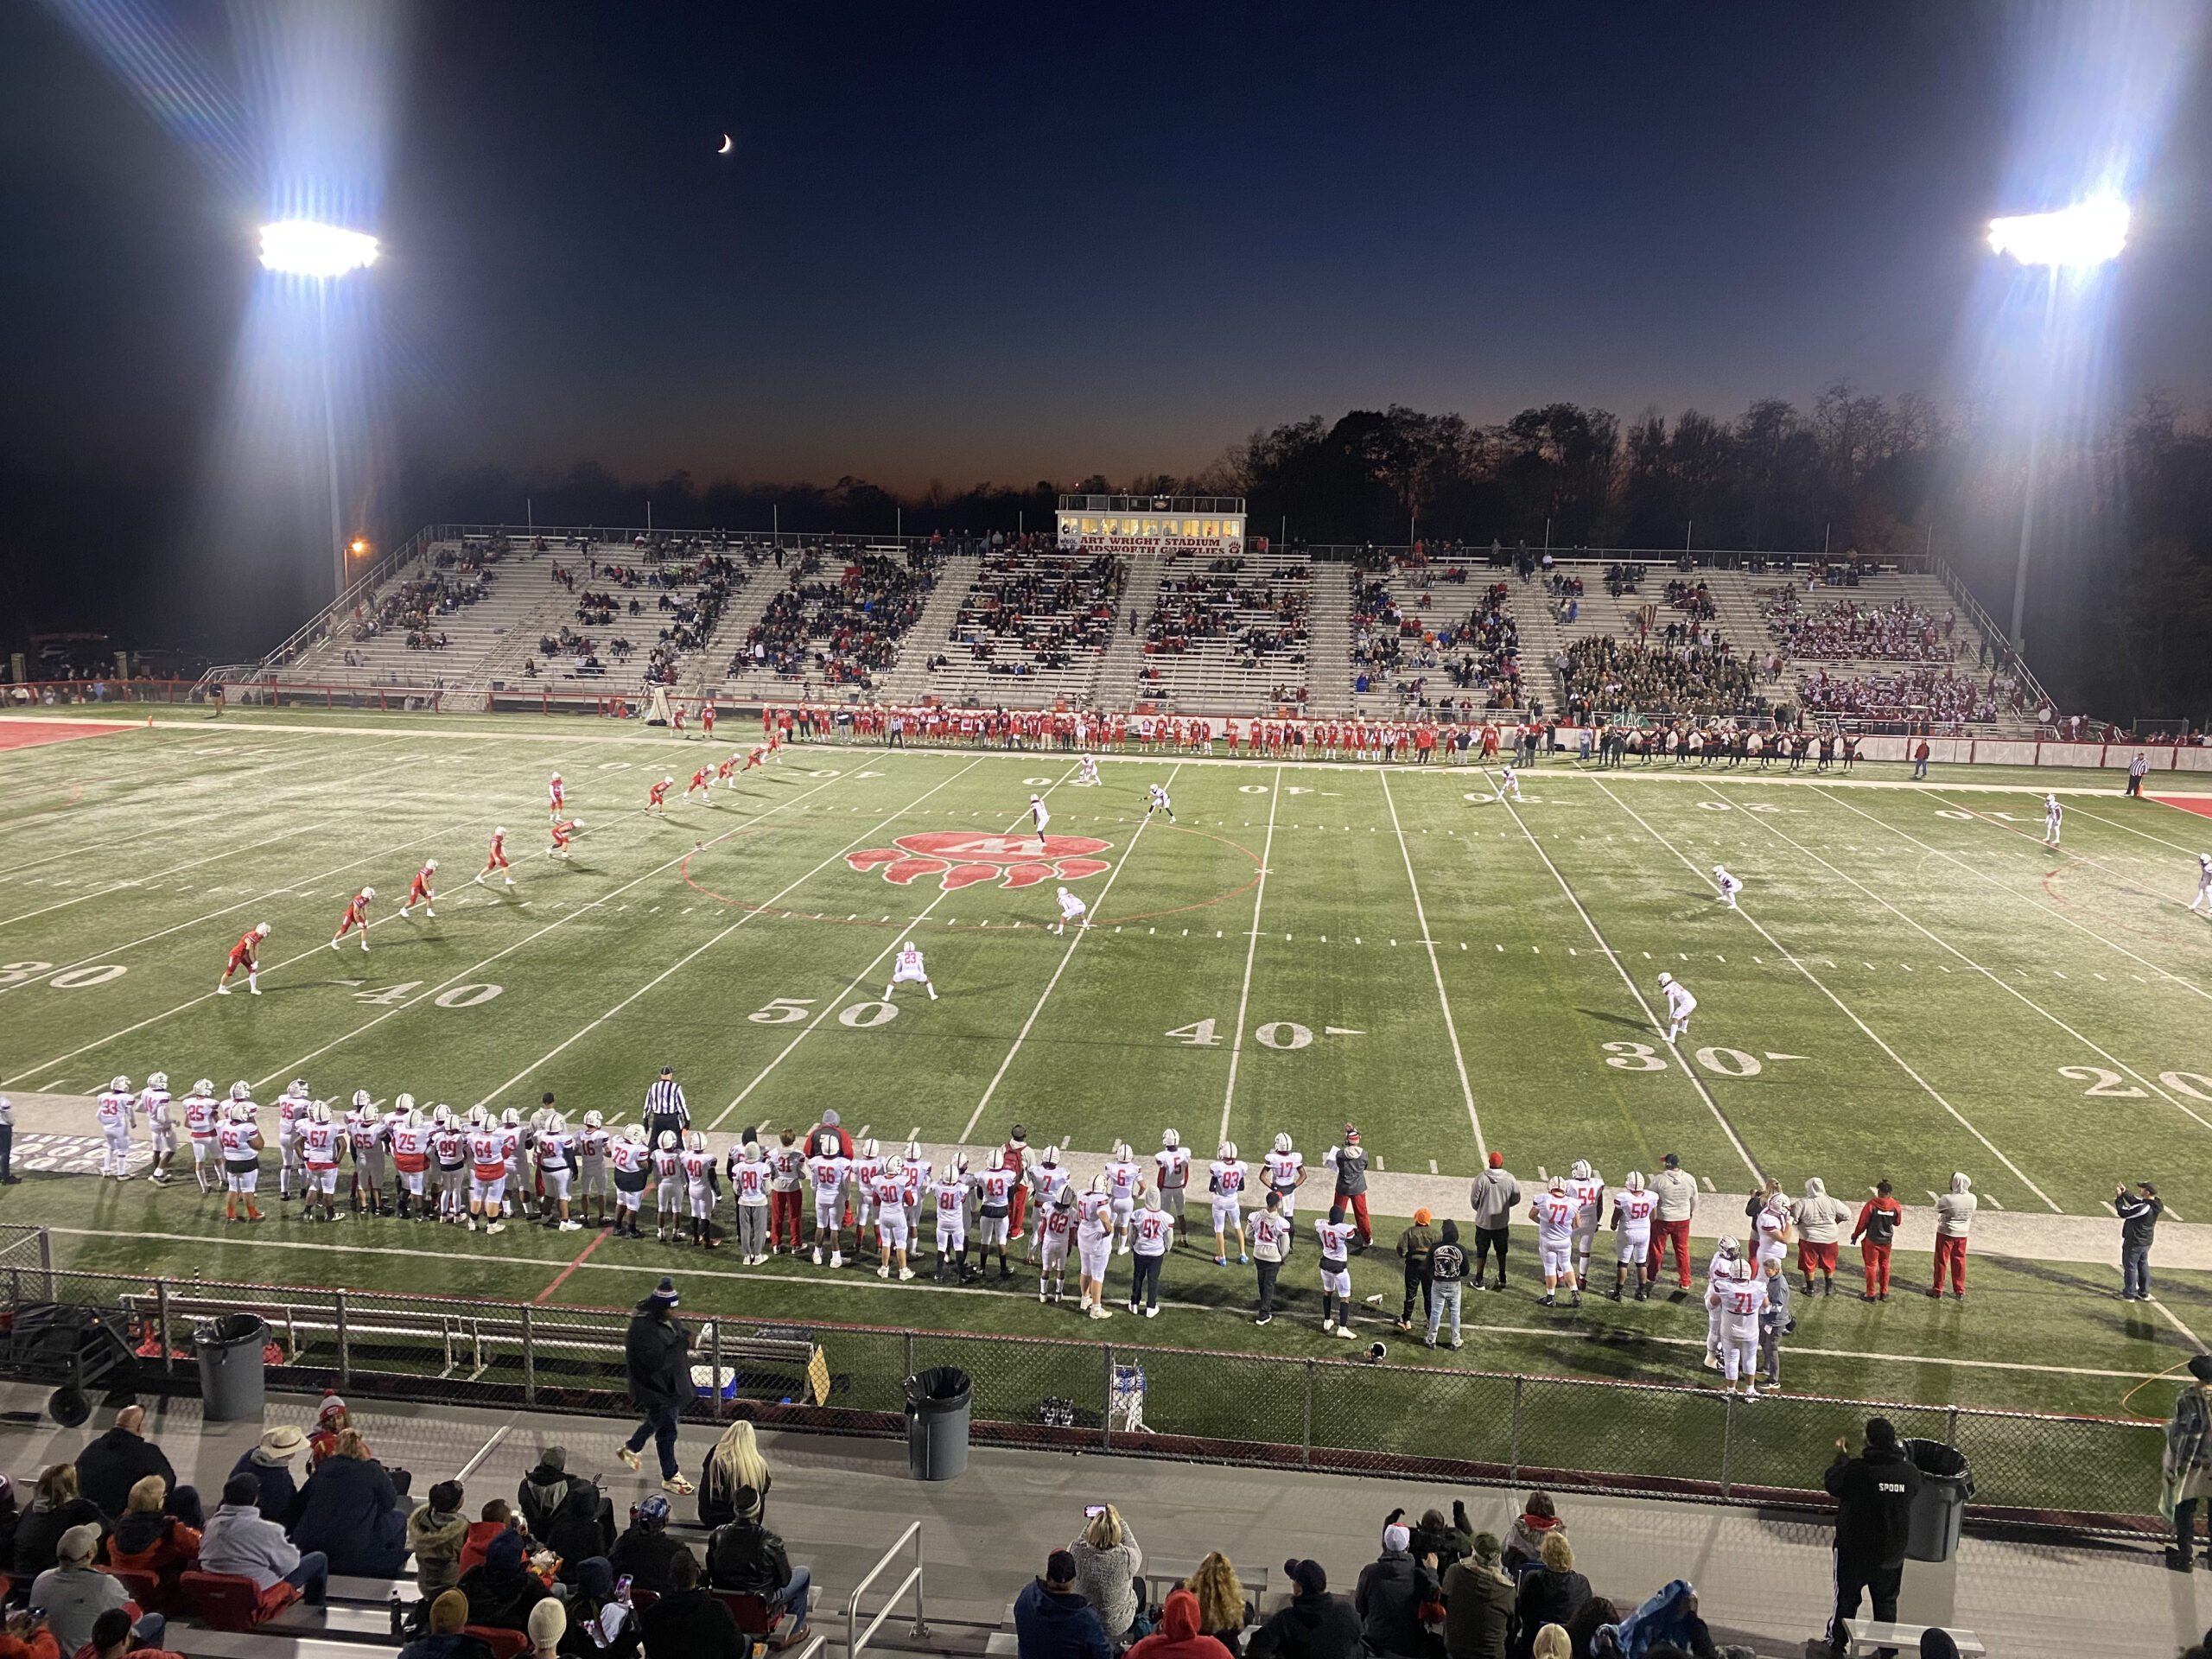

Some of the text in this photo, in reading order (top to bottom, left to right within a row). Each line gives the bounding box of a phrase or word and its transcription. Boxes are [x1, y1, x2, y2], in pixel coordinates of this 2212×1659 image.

[1080, 545, 1156, 554] ADSWORTH
[1109, 537, 1160, 546] WRIGHT
[1165, 538, 1221, 547] STADIUM
[905, 952, 917, 964] 23
[102, 1099, 118, 1116] 33
[188, 1105, 205, 1122] 25
[280, 1102, 295, 1120] 35
[222, 1130, 238, 1148] 66
[310, 1130, 327, 1148] 67
[354, 1133, 373, 1150] 65
[399, 1133, 417, 1151] 75
[582, 1140, 595, 1156] 16
[474, 1141, 492, 1159] 64
[612, 1146, 628, 1166] 72
[661, 1159, 676, 1177] 10
[687, 1160, 702, 1179] 40
[777, 1156, 792, 1173] 31
[1173, 1156, 1181, 1175] 5
[1278, 1161, 1294, 1178] 17
[817, 1166, 835, 1184] 56
[861, 1166, 877, 1185] 84
[1043, 1175, 1052, 1192] 7
[1117, 1169, 1126, 1186] 6
[1222, 1172, 1239, 1189] 83
[880, 1185, 899, 1203] 30
[987, 1178, 1004, 1196] 43
[940, 1192, 955, 1211] 81
[1578, 1188, 1596, 1206] 54
[1077, 1200, 1089, 1222] 61
[1549, 1204, 1568, 1224] 77
[1631, 1203, 1649, 1219] 58
[1321, 1230, 1338, 1250] 13
[1734, 1292, 1753, 1313] 71
[1878, 1483, 1906, 1493] SPOON
